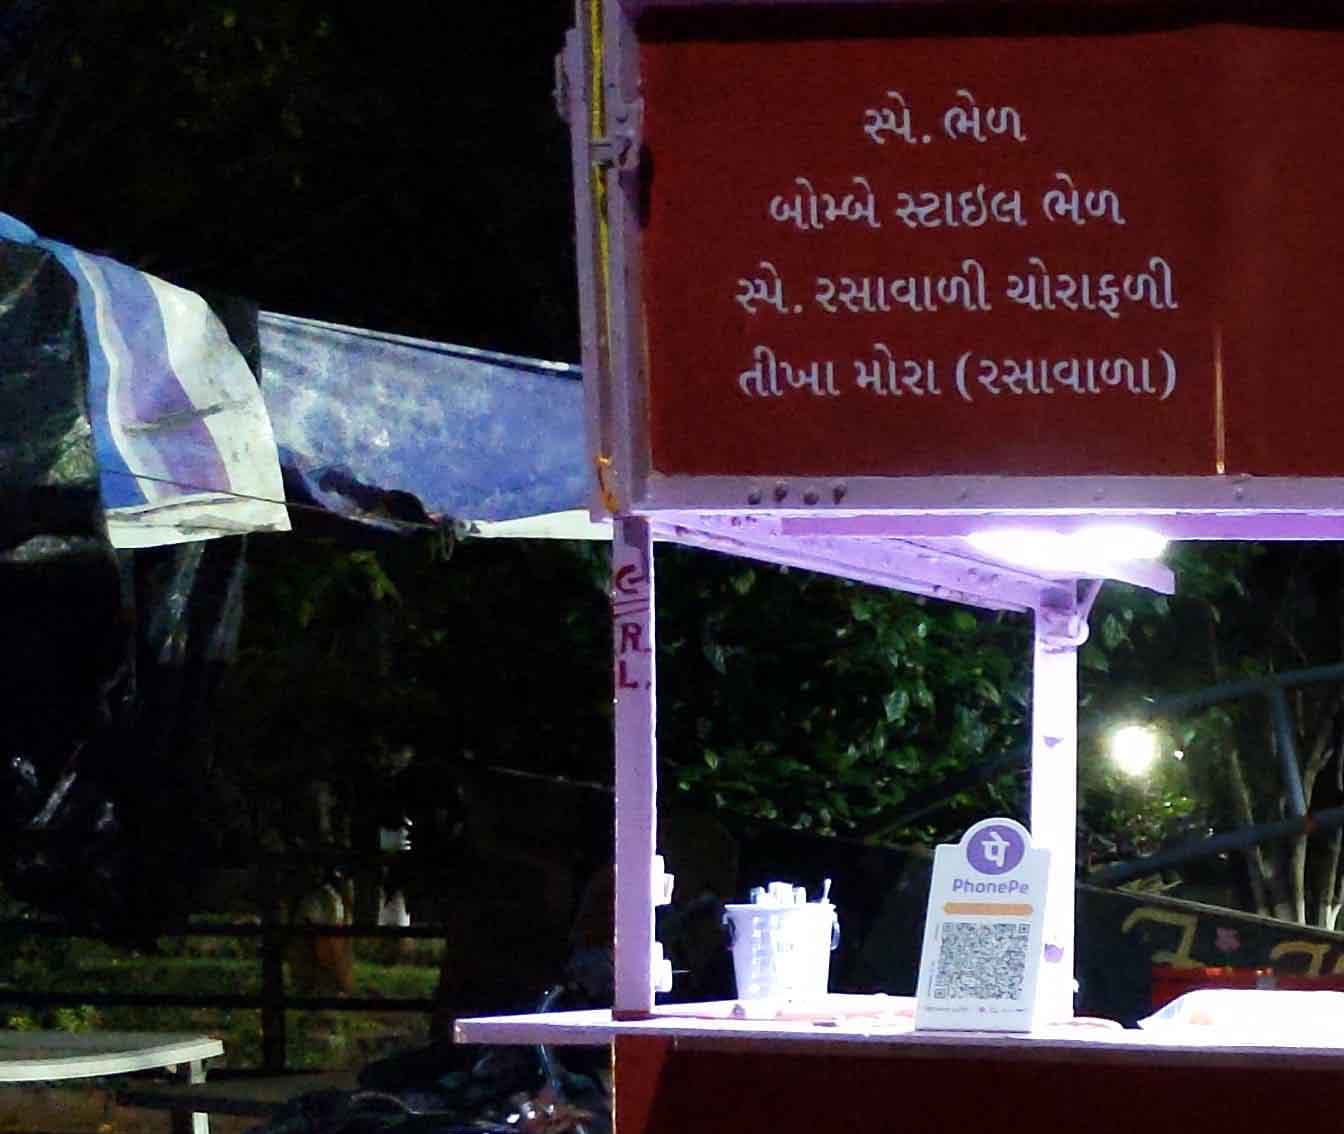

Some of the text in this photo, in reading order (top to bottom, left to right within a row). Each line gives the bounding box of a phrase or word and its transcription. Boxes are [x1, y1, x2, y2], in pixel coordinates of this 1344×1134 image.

[863, 89, 1027, 145] સ્પે. ભેળ
[769, 176, 882, 231] બોમ્બે
[1041, 171, 1127, 226] ભેળ
[734, 256, 1179, 319] સ્પે. રસાવાળી ચોરાફળી
[738, 342, 1178, 401] તીખા મોરા (રસાવાળા)
[952, 878, 1031, 895] PhonePe
